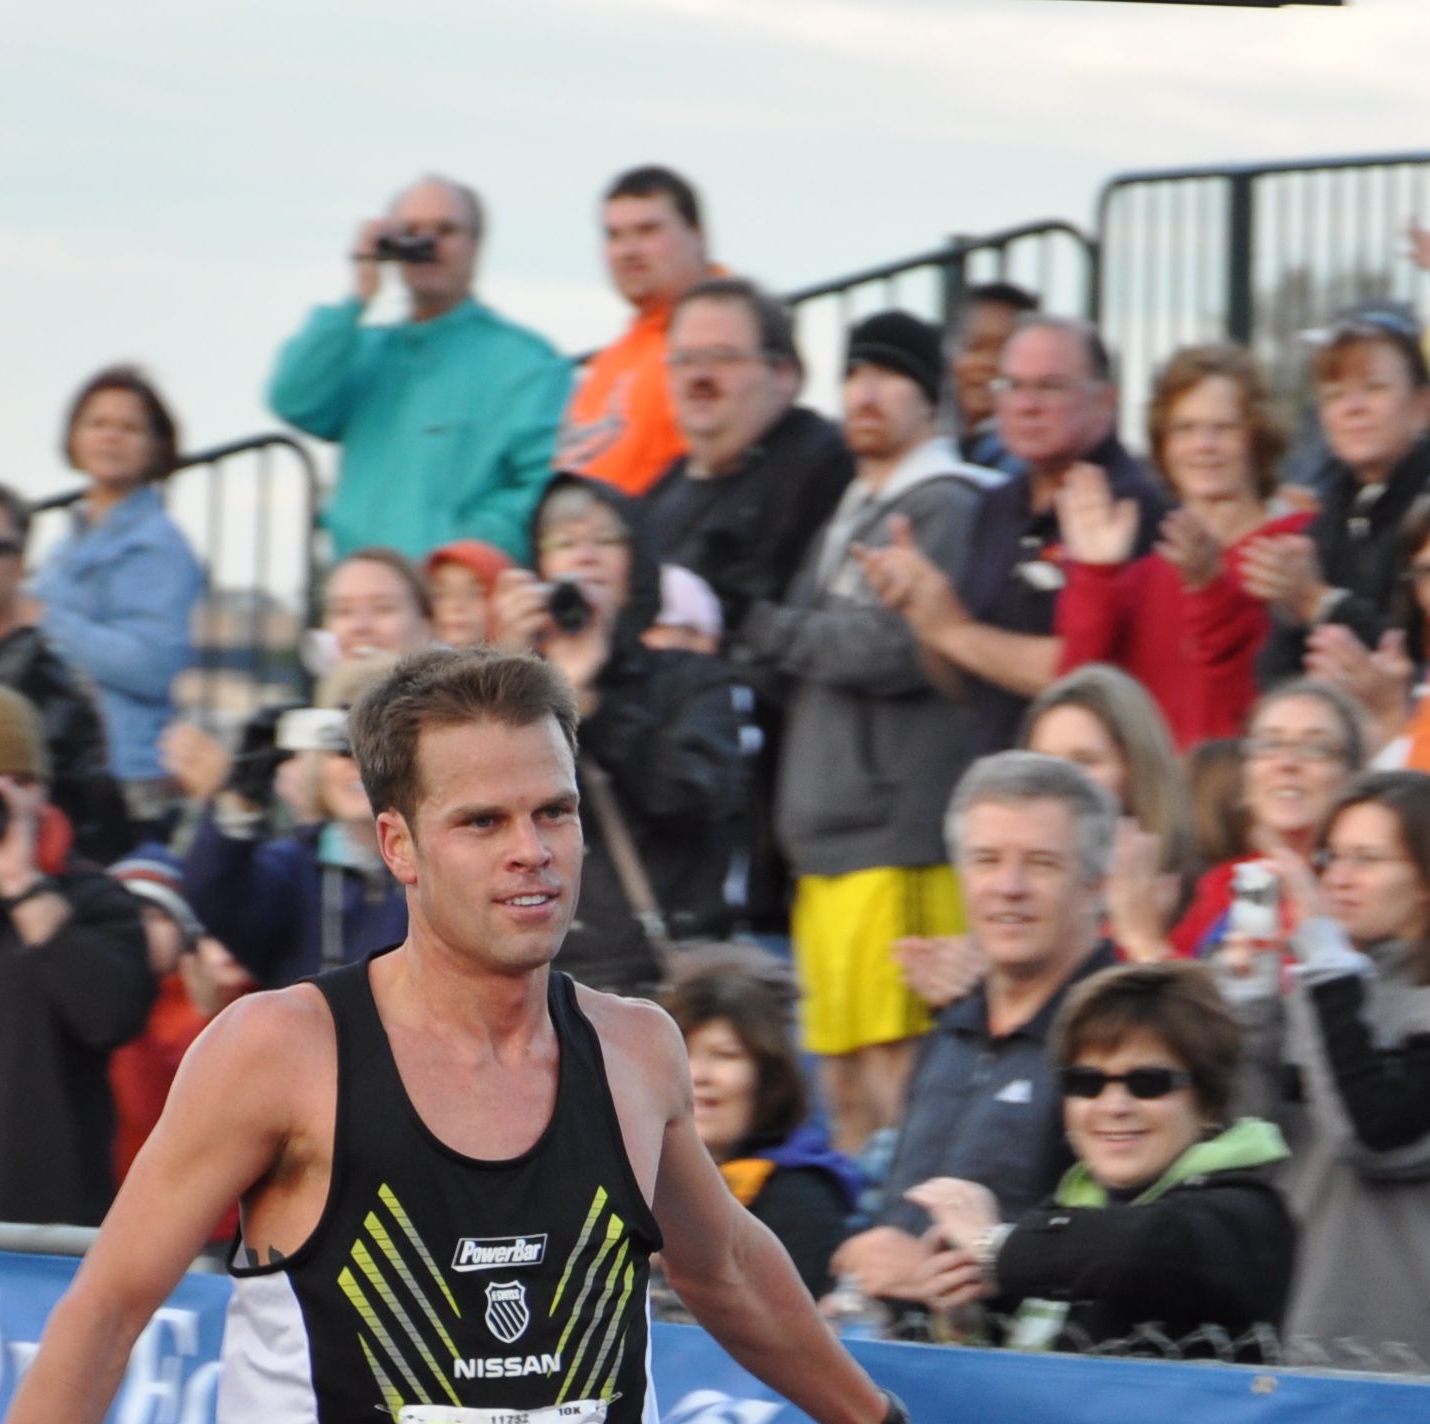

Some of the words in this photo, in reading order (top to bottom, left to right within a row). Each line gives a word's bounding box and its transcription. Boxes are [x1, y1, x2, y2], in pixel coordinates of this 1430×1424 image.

[460, 1239, 542, 1264] PowerBar
[454, 1353, 561, 1379] NISSAN
[559, 1405, 582, 1417] 10K
